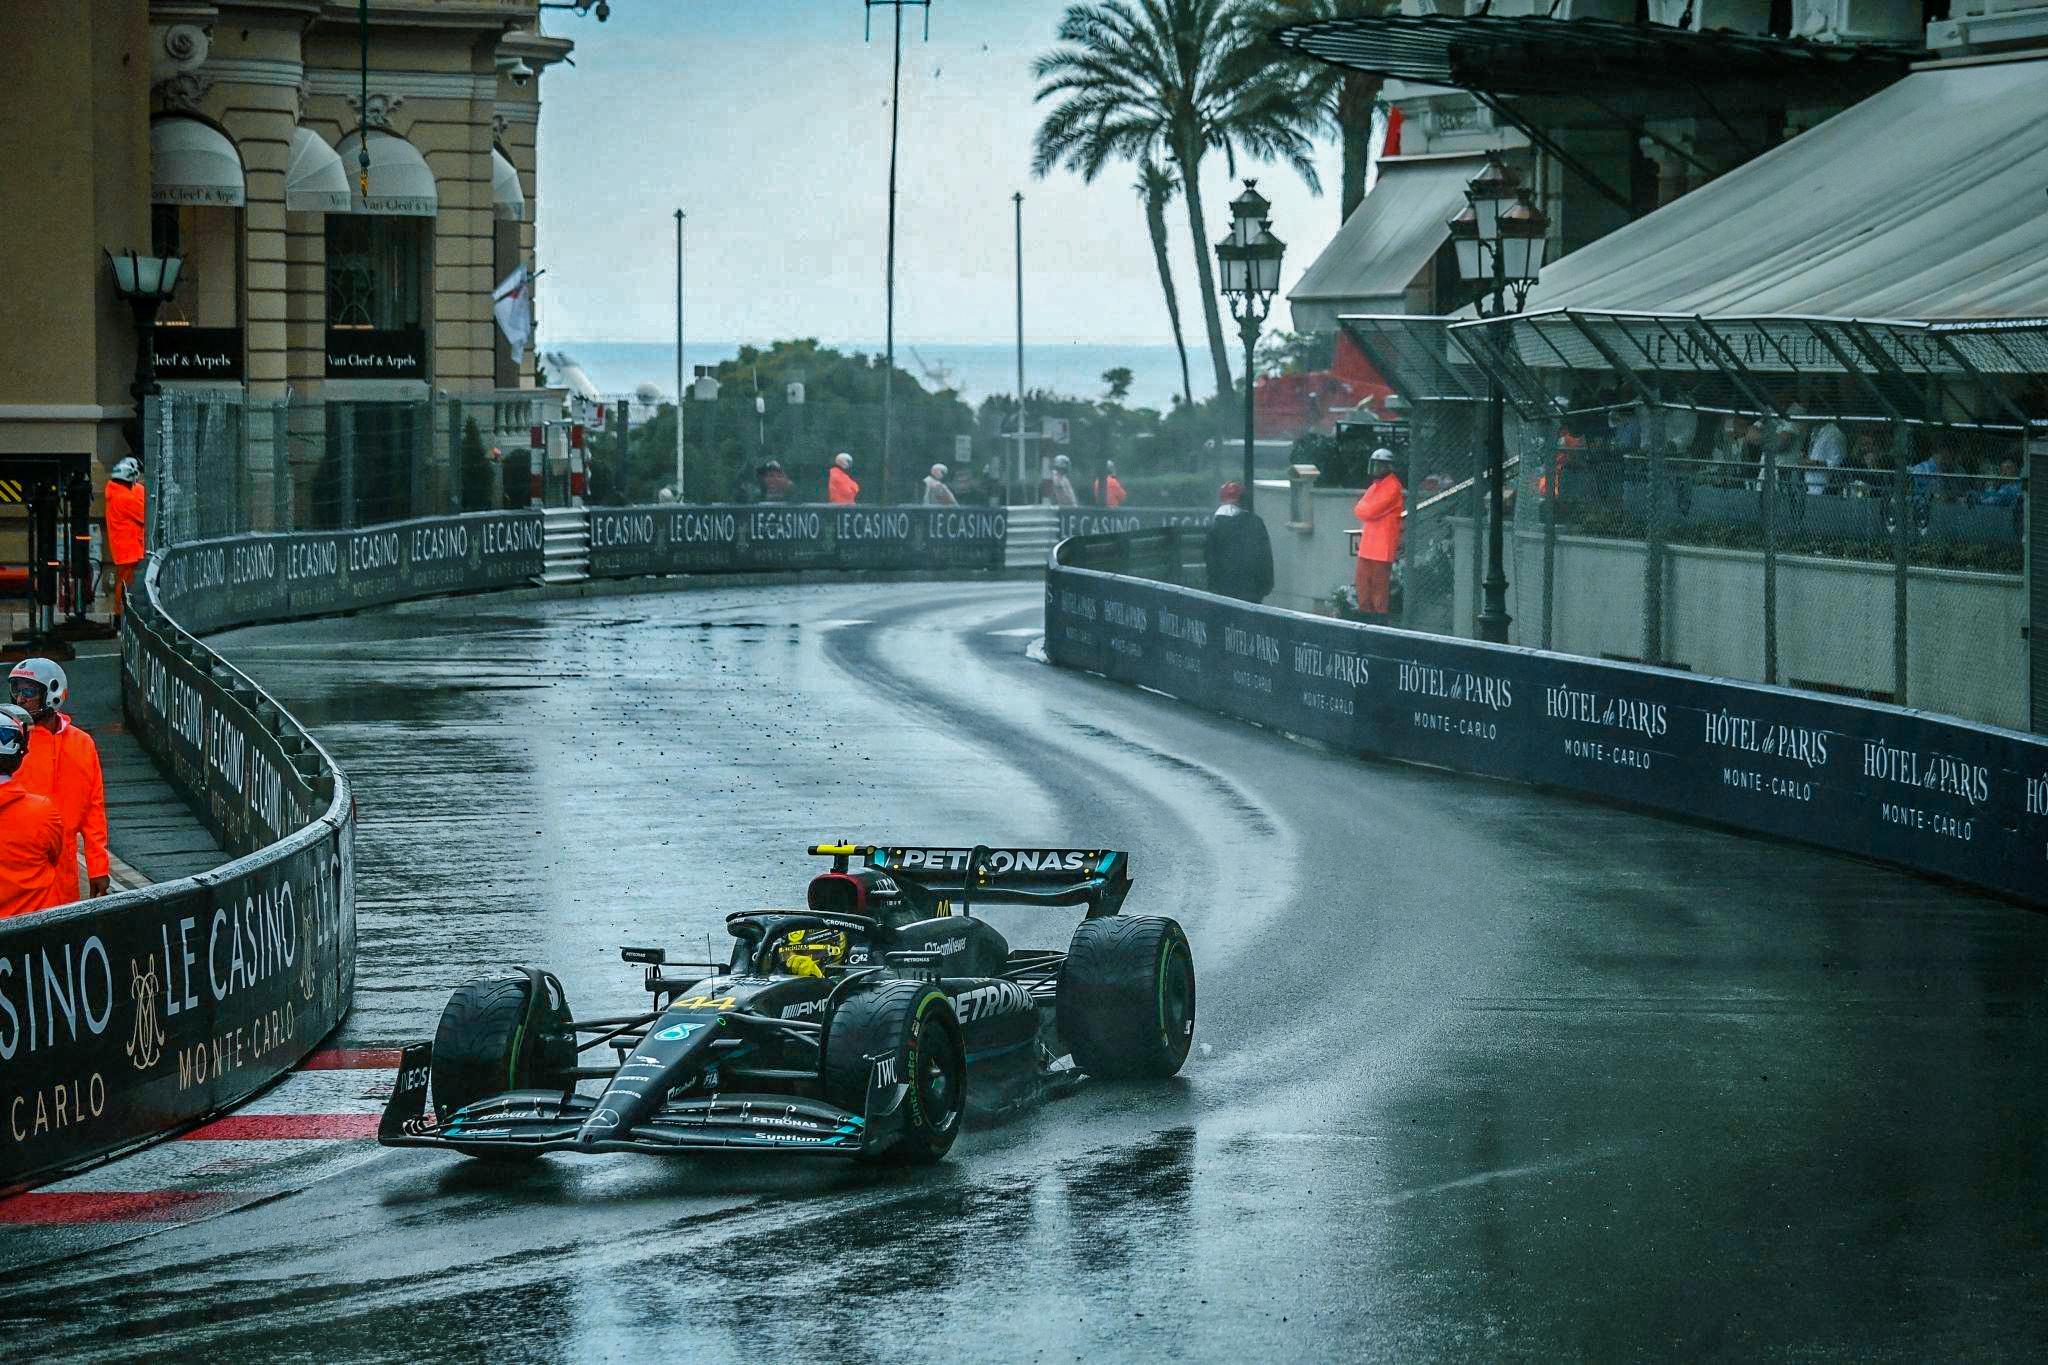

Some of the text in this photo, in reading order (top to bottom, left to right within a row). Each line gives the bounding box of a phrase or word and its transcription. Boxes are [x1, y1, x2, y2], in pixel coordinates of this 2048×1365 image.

[155, 352, 231, 370] leef & Arpels
[348, 353, 375, 367] Cleef
[376, 354, 386, 367] &
[387, 354, 417, 371] Arpels
[496, 519, 543, 553] CASINO
[605, 515, 655, 545] CASINO
[685, 514, 735, 542] CASINO
[766, 513, 821, 539] CASINO
[852, 512, 910, 539] CASINO
[946, 513, 1005, 540] CASINO
[361, 532, 399, 570] CASINO
[423, 525, 468, 561] CASINO
[300, 540, 337, 578] CASINO
[1334, 652, 1369, 688] PARIS
[1398, 659, 1513, 712] HÔTEL de PARIS
[1546, 682, 1668, 740] HÔTEL de PARIS
[1703, 705, 1829, 768] HÔTEL de PARIS
[1863, 737, 1991, 806] HÔTEL de PARIS
[902, 848, 1087, 872] PETONAS
[162, 916, 199, 1016] LE
[209, 880, 296, 1001] CASINO
[670, 996, 737, 1010] 44
[401, 1066, 428, 1094] INEOS
[875, 1056, 898, 1089] IWC
[12, 1072, 106, 1142] CARLO
[752, 1116, 818, 1129] PETRONAS
[755, 1132, 821, 1143] Syntium
